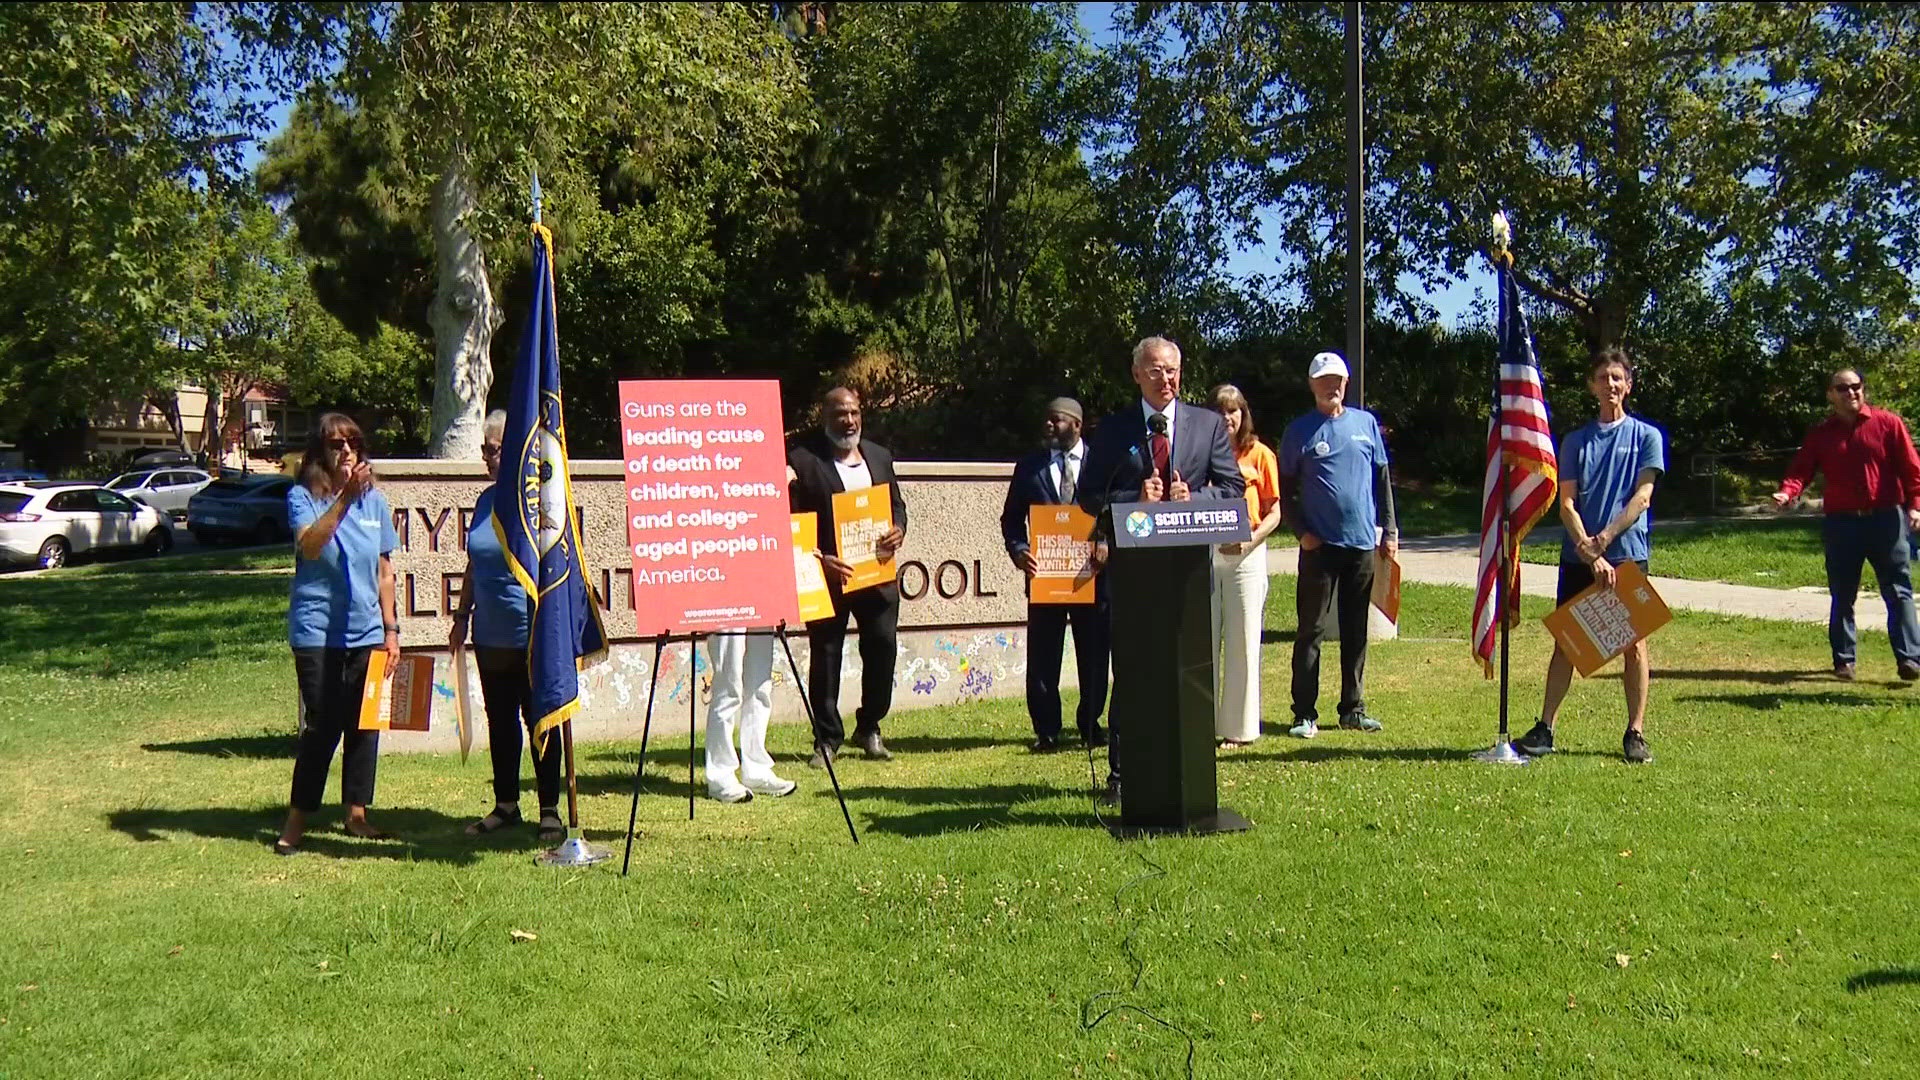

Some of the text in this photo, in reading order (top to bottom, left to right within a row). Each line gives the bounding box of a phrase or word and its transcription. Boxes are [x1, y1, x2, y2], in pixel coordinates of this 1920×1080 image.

[624, 399, 747, 418] Guns are the
[626, 426, 765, 449] leading cause
[628, 453, 742, 473] of death for
[630, 480, 781, 501] children, teens,
[632, 509, 758, 530] and college-
[1154, 509, 1239, 526] SCOTT PETERS
[635, 534, 778, 562] aged people in
[1035, 535, 1057, 549] THIS
[638, 566, 726, 586] America.
[683, 606, 756, 618] wearorange.org
[1585, 591, 1631, 647] AWARENESS
